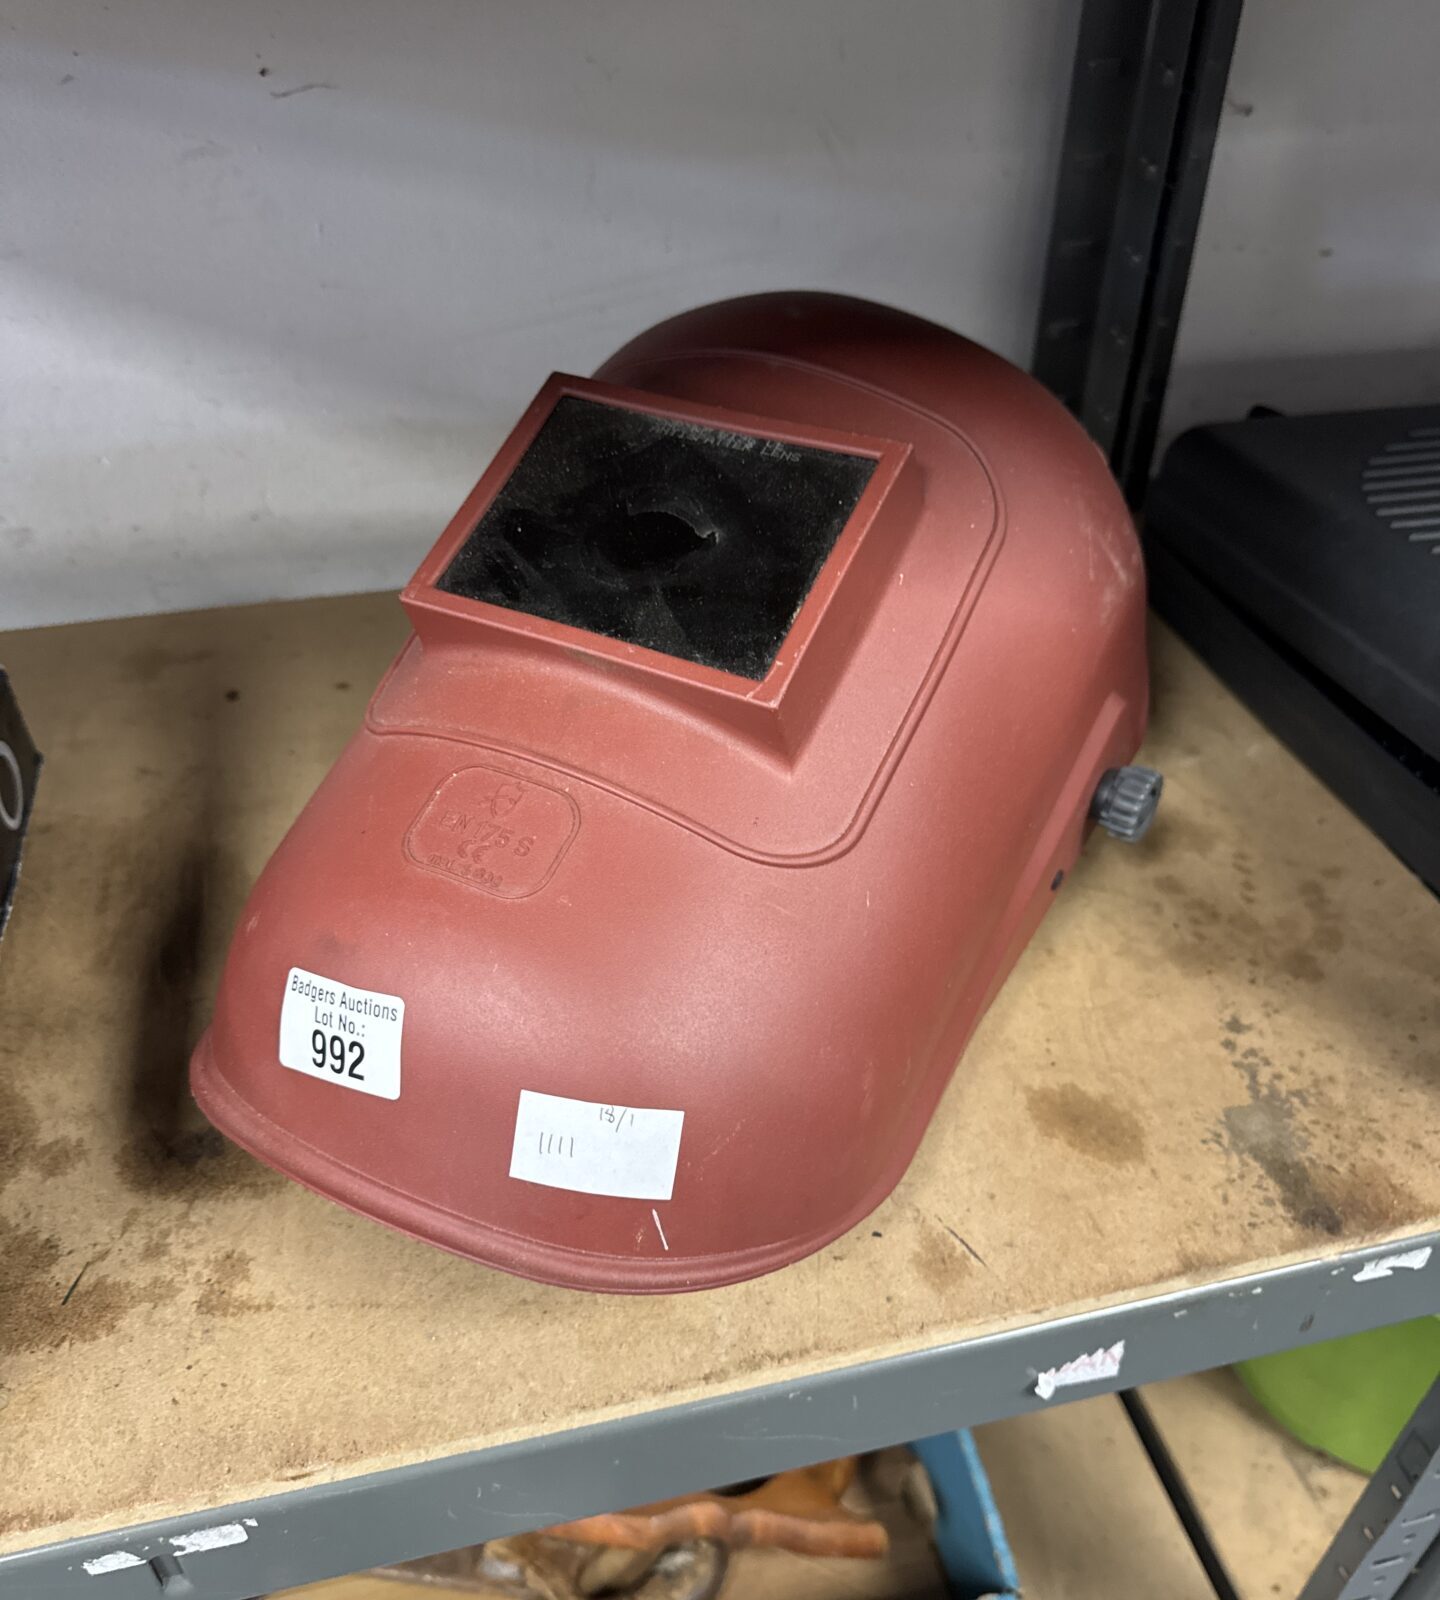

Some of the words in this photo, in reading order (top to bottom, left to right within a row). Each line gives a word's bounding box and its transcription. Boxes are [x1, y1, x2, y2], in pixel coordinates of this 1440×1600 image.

[440, 811, 474, 834] EN
[473, 821, 515, 849] 175
[513, 836, 535, 858] S
[291, 974, 337, 1006] Badgers
[339, 991, 399, 1022] Auctions
[314, 1005, 334, 1029] Lot
[337, 1013, 367, 1038] No.:
[311, 1028, 366, 1082] 992
